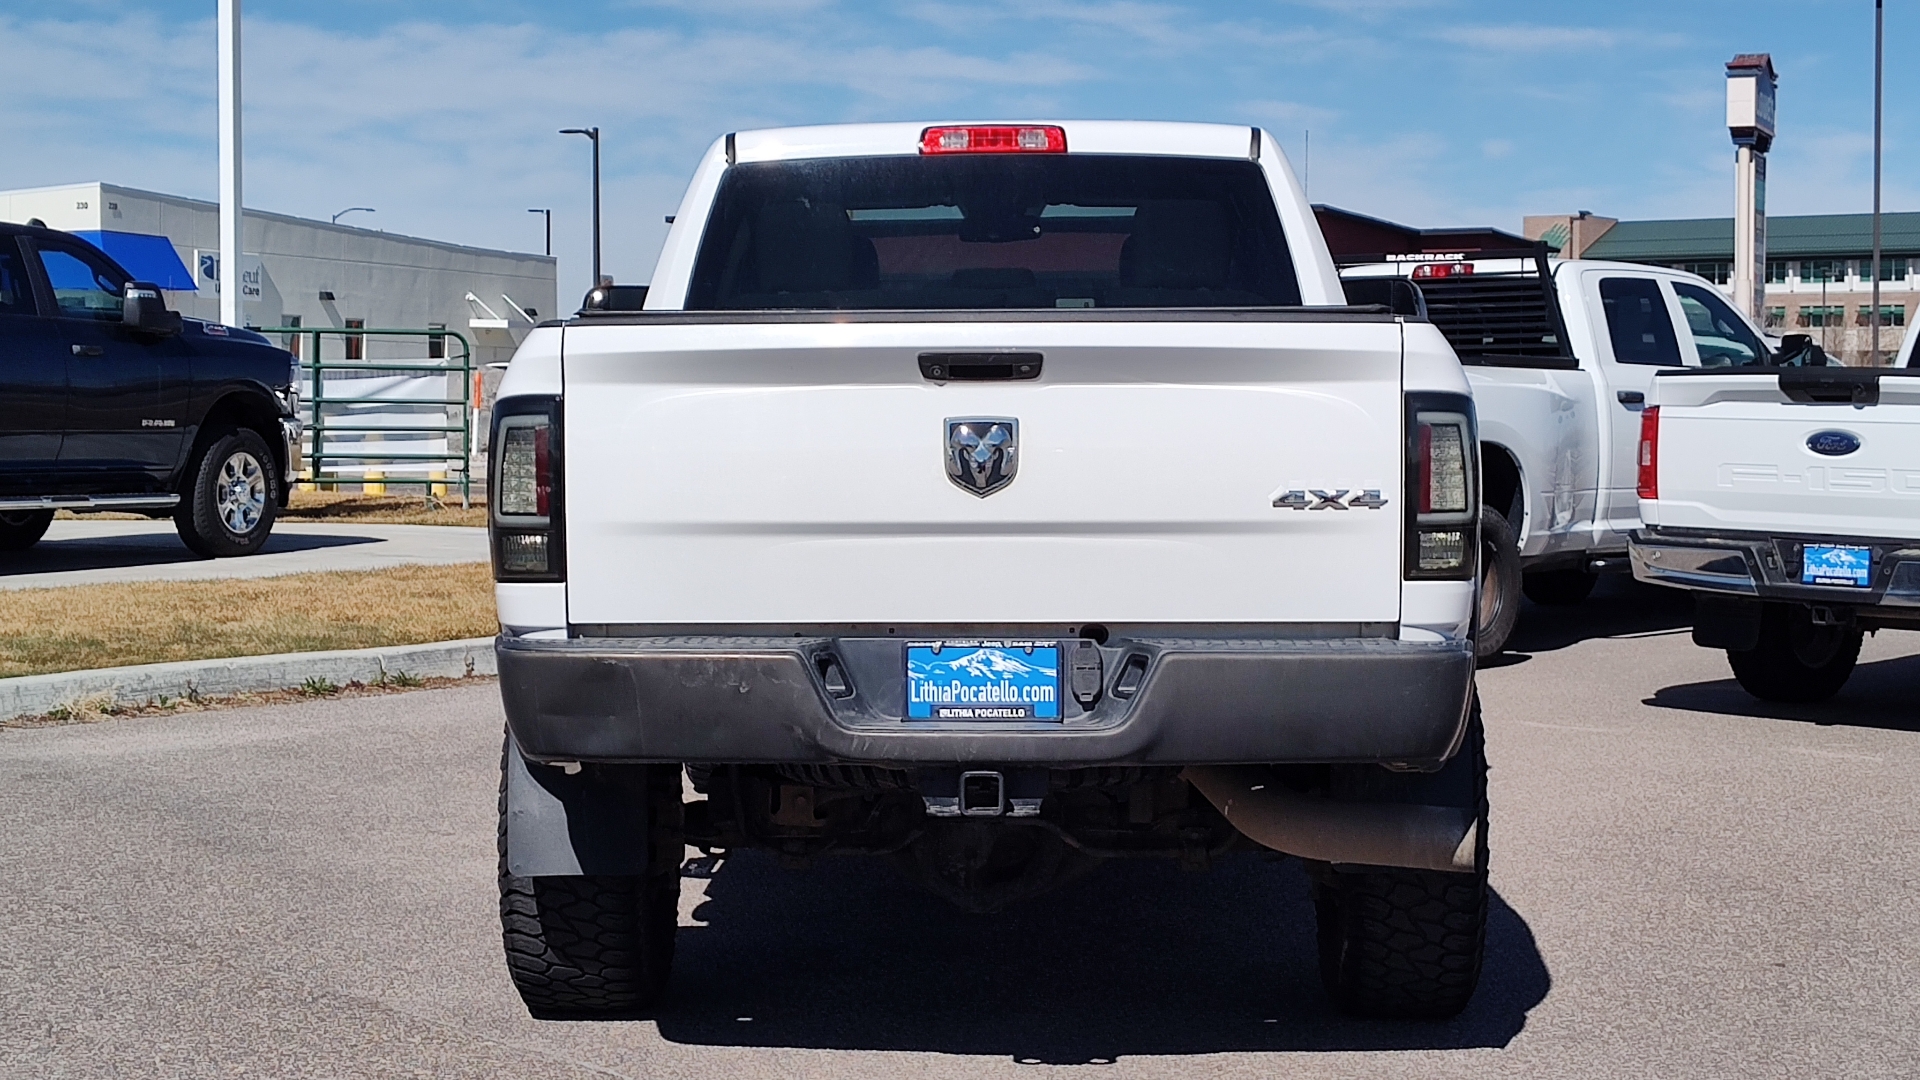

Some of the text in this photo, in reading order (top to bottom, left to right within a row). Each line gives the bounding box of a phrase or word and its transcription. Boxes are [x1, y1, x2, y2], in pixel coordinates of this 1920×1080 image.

[1386, 253, 1465, 261] BACKRACK
[141, 419, 176, 427] RAM
[1272, 489, 1389, 510] 4X4
[911, 680, 1054, 702] LithiaPocatello.com
[948, 708, 1026, 718] LITHIA POCATELLO
